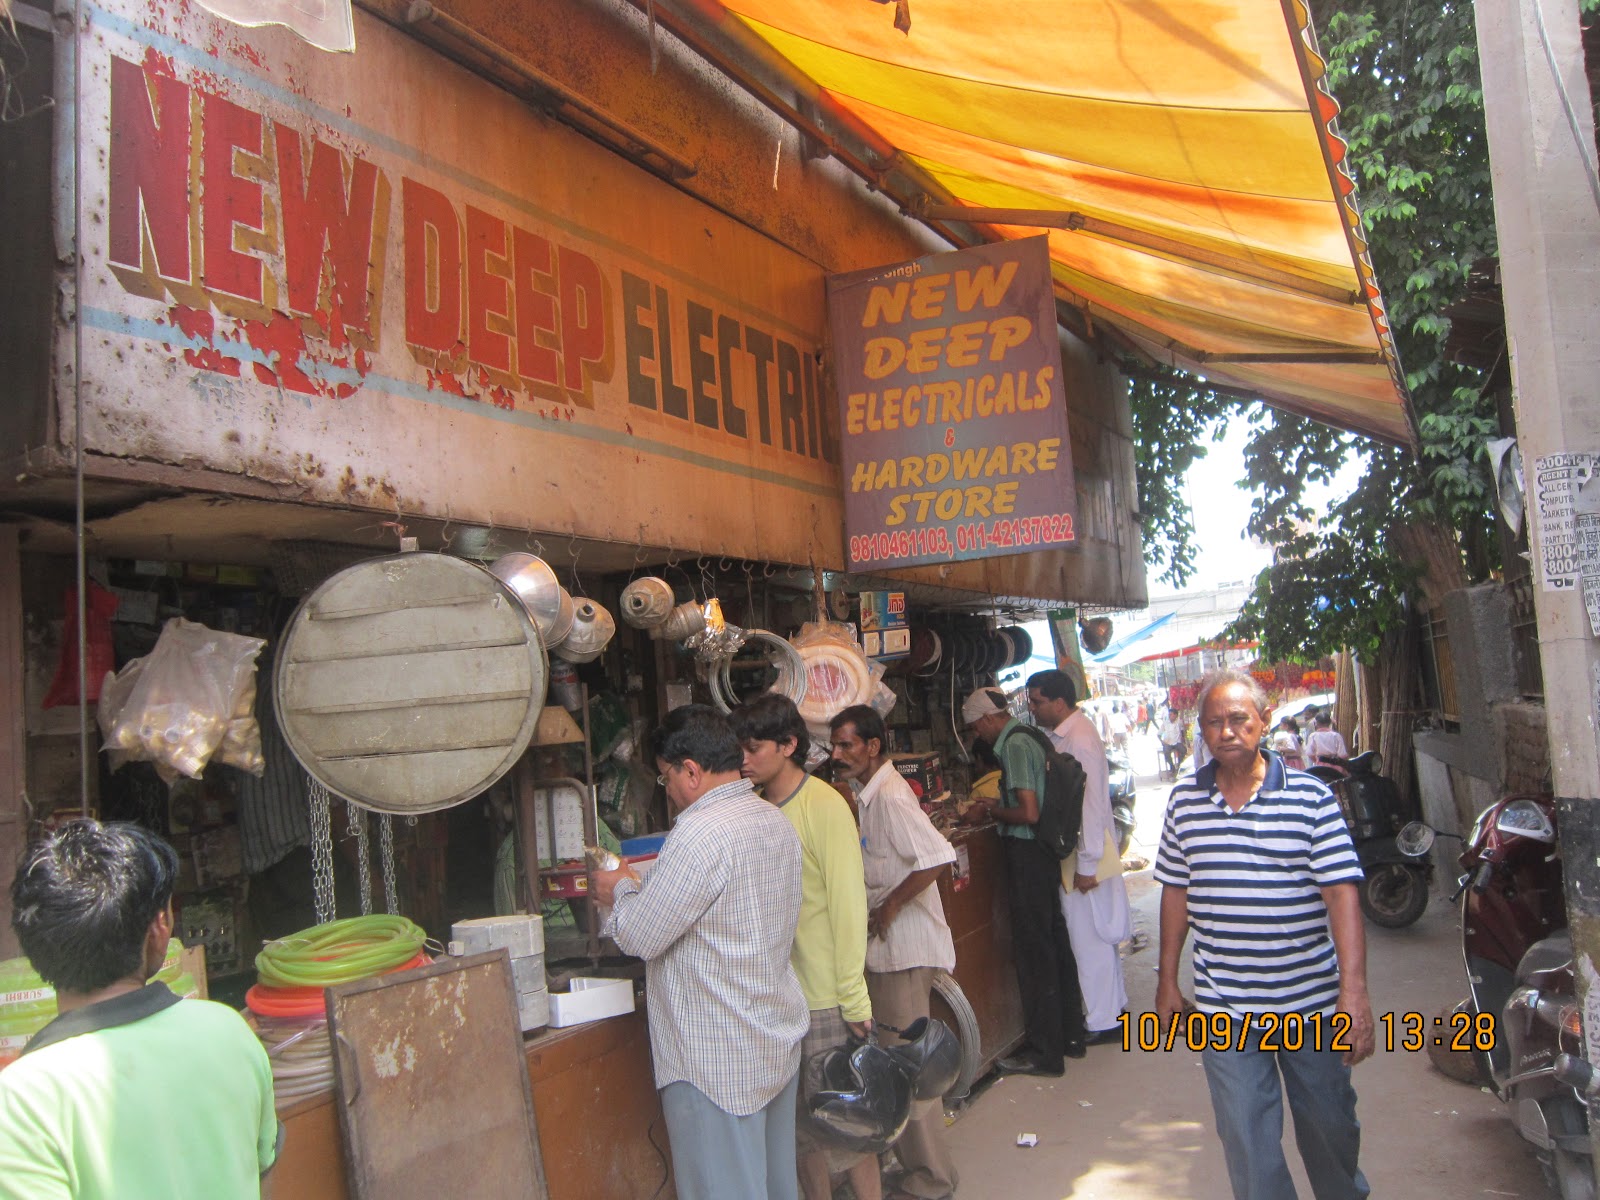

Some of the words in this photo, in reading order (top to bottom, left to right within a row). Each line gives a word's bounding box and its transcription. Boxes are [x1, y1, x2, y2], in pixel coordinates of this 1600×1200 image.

[107, 54, 386, 348] NEW
[402, 176, 612, 405] DEEP
[862, 261, 1020, 328] NEW
[863, 315, 1032, 380] DEEP
[846, 365, 1055, 435] ELECTRICALS
[944, 427, 955, 448] &
[851, 437, 1061, 493] HARDWARE
[1542, 470, 1569, 481] RGENT
[885, 481, 1019, 526] STORE
[850, 526, 954, 563] 9810461103,
[956, 513, 1075, 551] 011-42137822
[5, 988, 43, 1003] SURBHI
